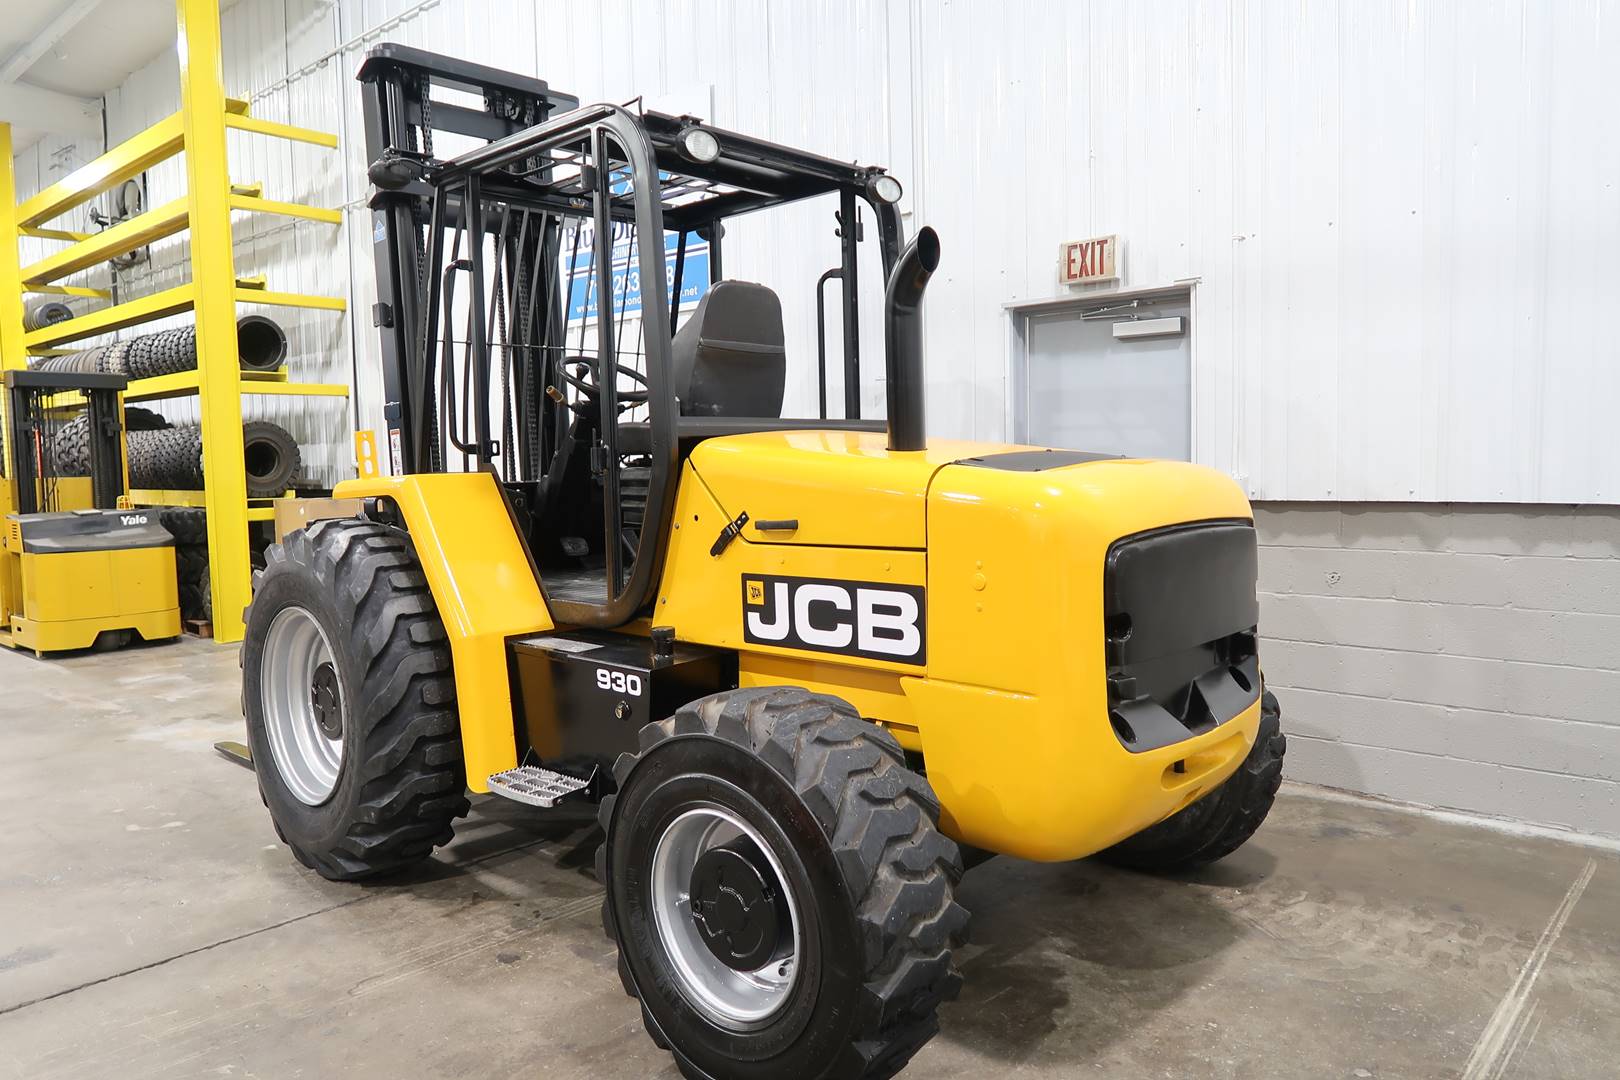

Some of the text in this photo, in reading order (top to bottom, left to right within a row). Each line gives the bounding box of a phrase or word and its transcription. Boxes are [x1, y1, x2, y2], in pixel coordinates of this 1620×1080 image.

[1067, 239, 1108, 280] EXIT
[120, 514, 148, 526] Yale
[747, 582, 921, 657] JCB
[596, 668, 642, 697] 930
